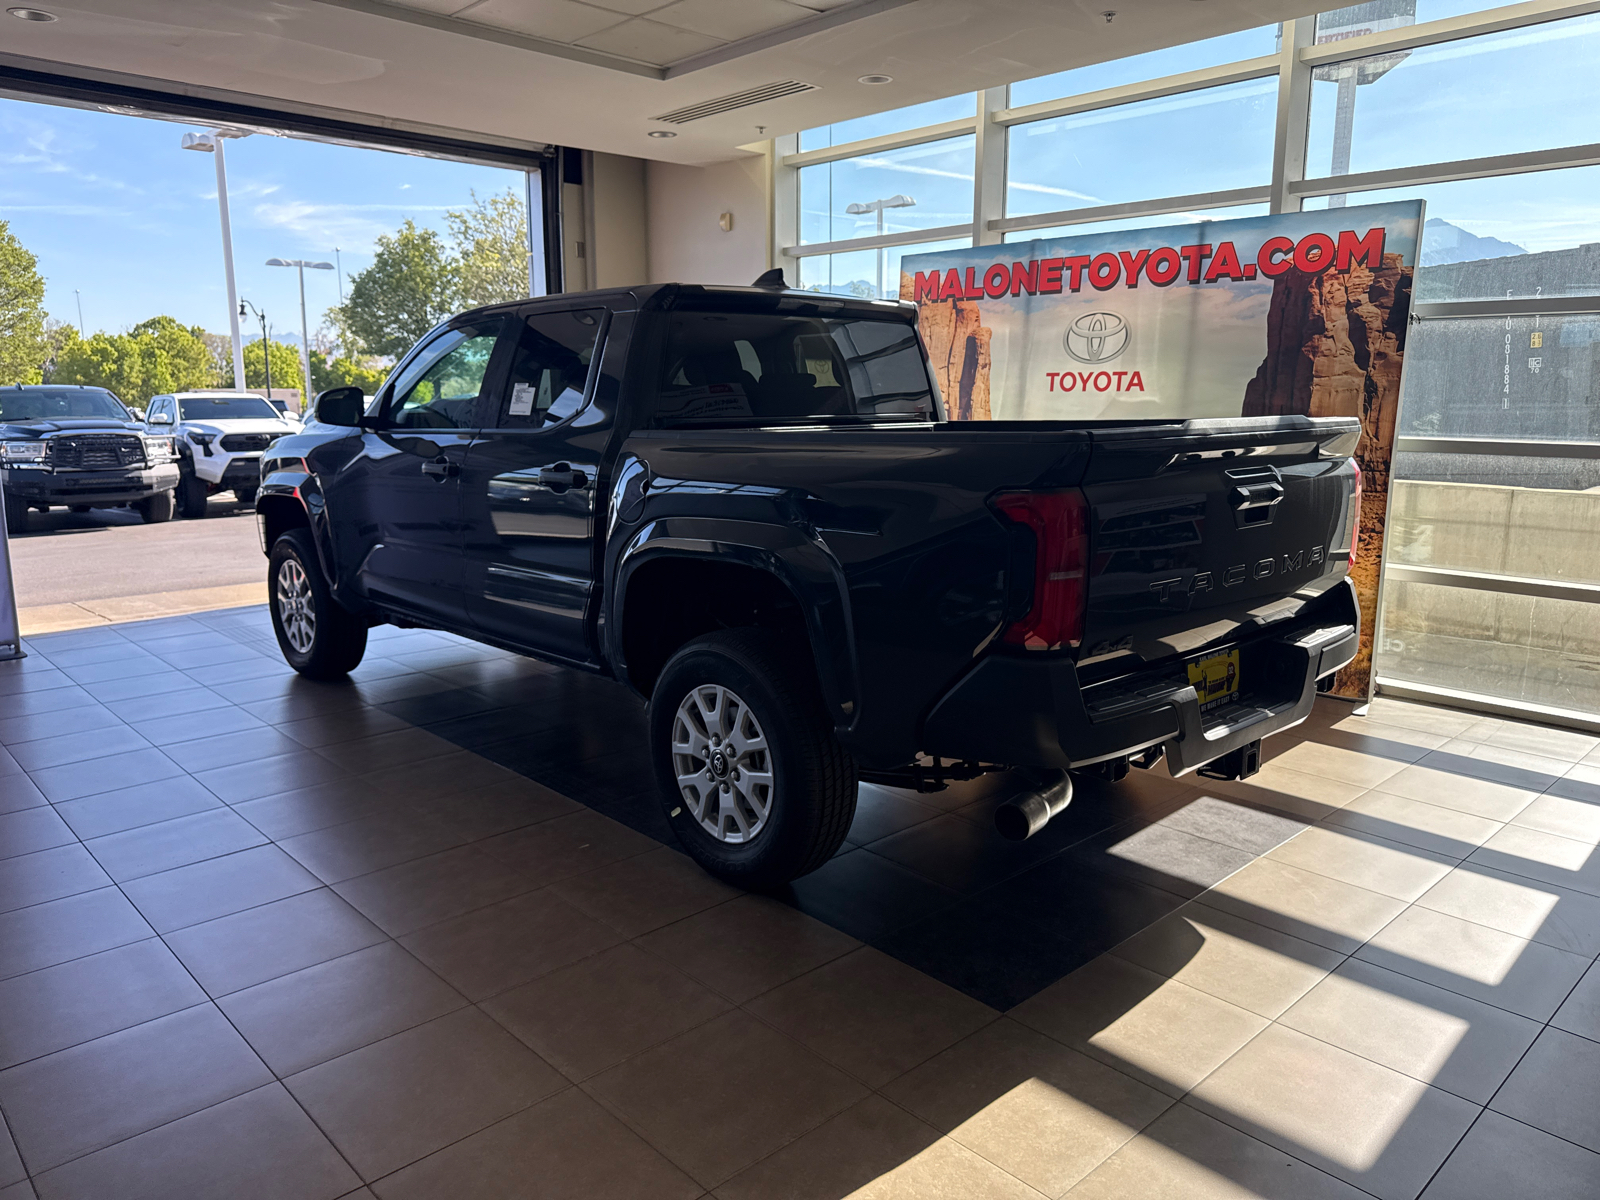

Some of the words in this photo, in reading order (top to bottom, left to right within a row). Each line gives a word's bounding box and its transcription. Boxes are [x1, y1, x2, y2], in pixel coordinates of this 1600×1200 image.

[914, 227, 1386, 302] MALONETOYOTA.COM
[1046, 370, 1145, 393] TOYOTA
[1149, 545, 1325, 602] TACOMA
